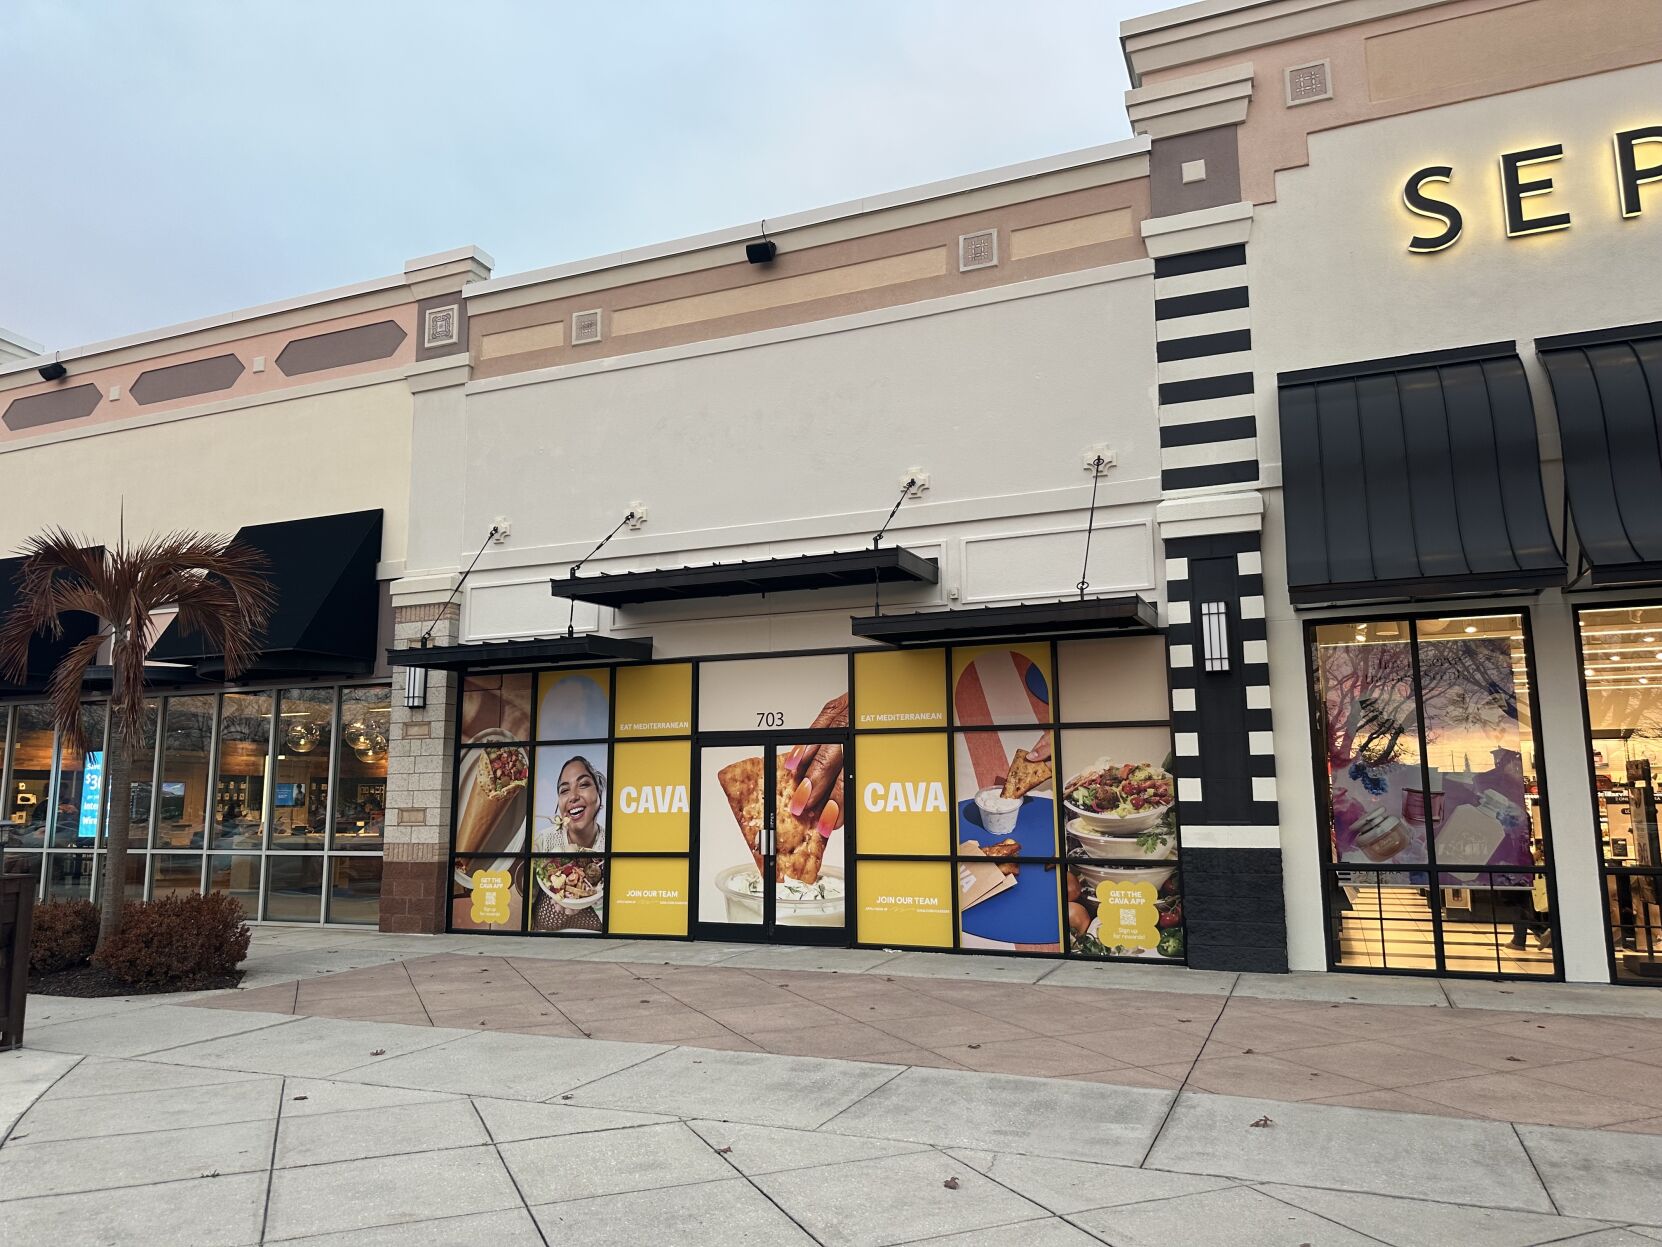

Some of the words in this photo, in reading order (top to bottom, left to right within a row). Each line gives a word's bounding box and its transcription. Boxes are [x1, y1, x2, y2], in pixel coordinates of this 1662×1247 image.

[756, 711, 785, 728] 703
[861, 714, 875, 722] EAT
[876, 712, 943, 721] MEDITERRANEAN
[620, 723, 632, 731] EAT
[633, 721, 689, 730] MEDITERRANEAN
[619, 785, 689, 814] CAVA
[863, 781, 947, 812] CAVA
[659, 890, 679, 898] TEAM
[1110, 890, 1125, 898] GET
[876, 896, 895, 904] JOIN
[896, 896, 913, 904] OUR
[914, 897, 938, 905] TEAM
